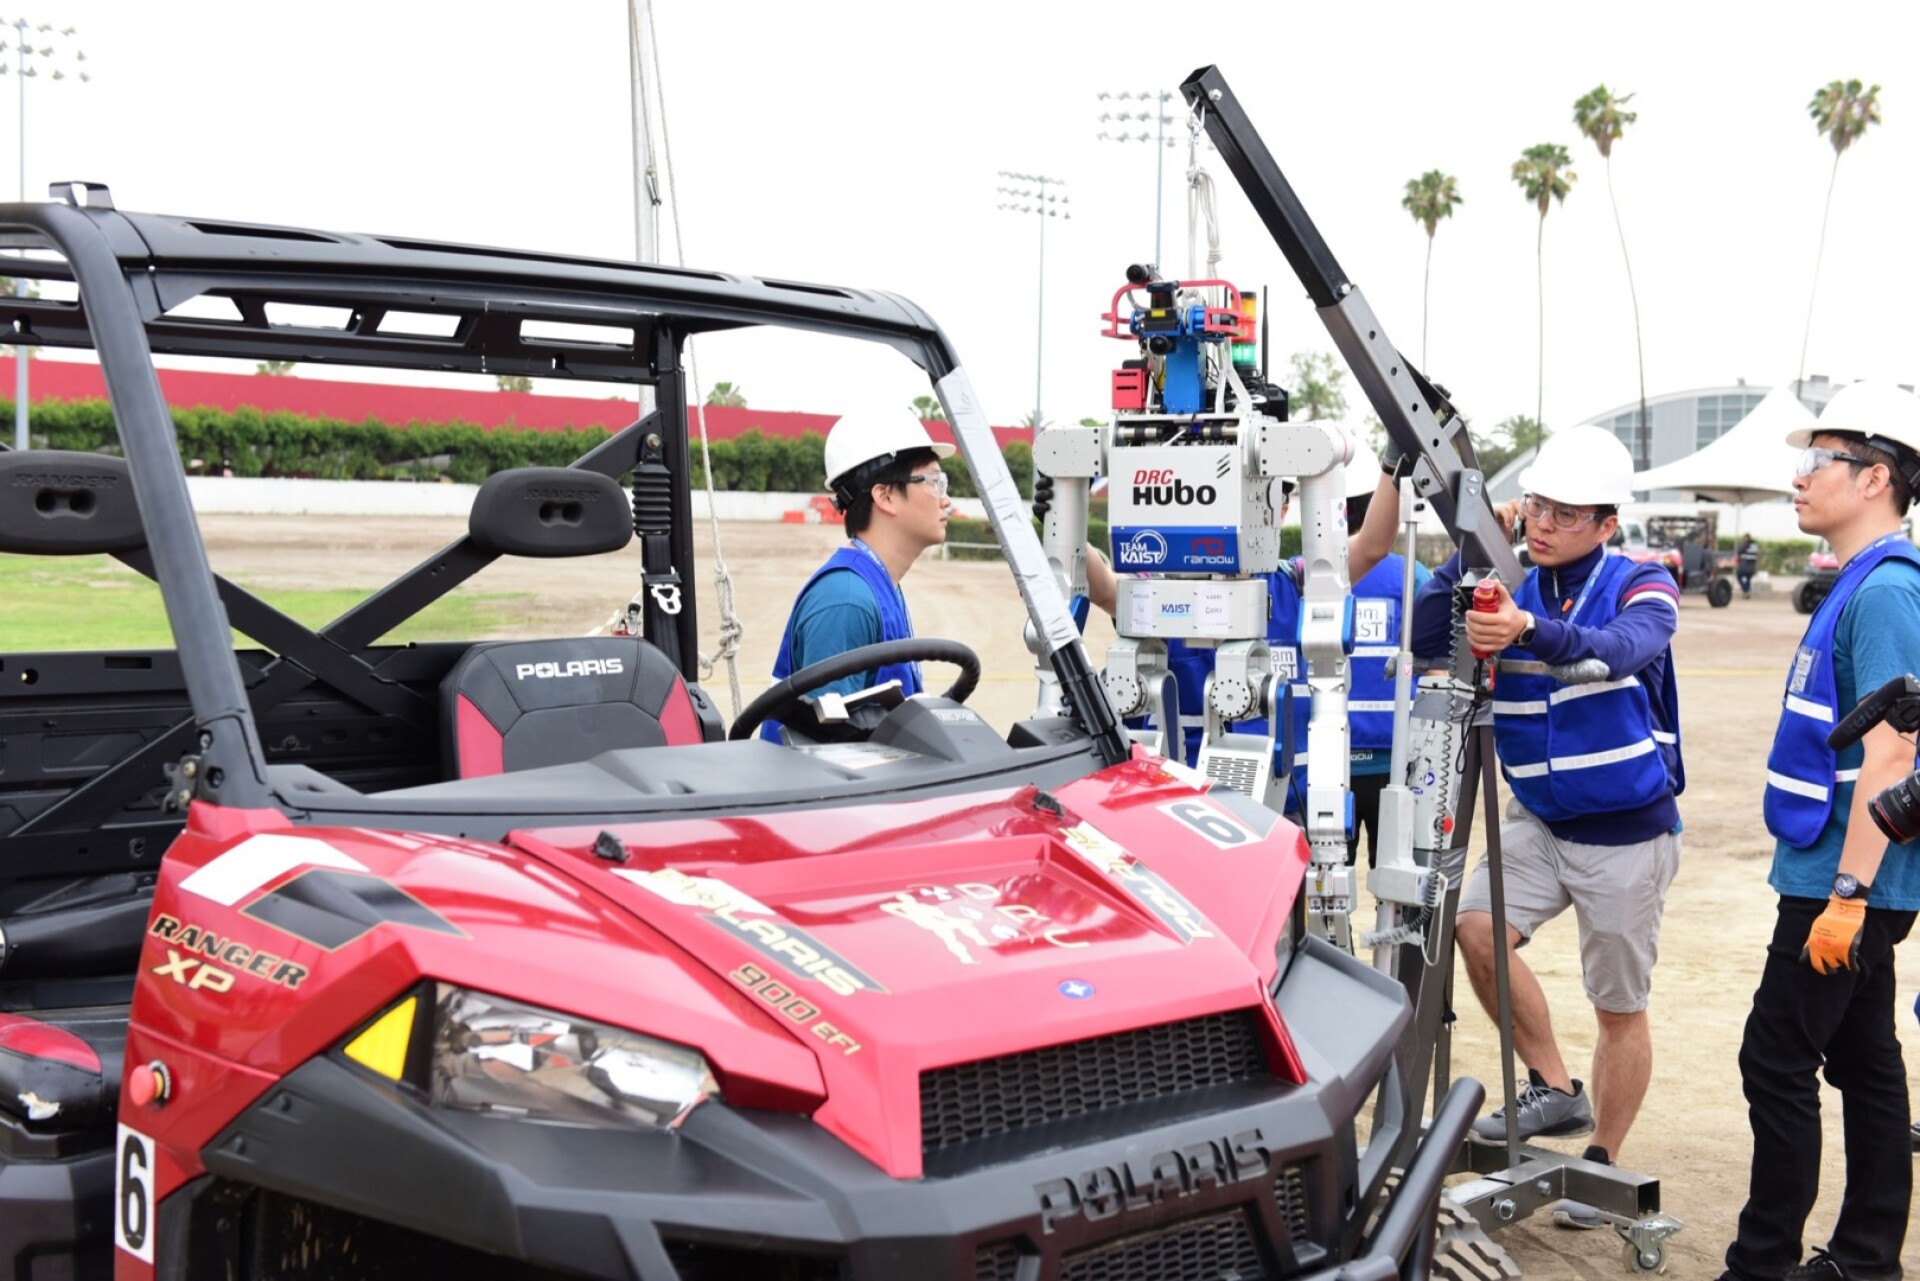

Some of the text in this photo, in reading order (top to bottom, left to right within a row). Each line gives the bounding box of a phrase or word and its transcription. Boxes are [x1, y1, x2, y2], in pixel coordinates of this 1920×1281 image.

[1133, 469, 1174, 485] DRC
[1119, 542, 1148, 553] TEAM
[1120, 551, 1161, 564] KAIST
[1183, 554, 1235, 565] rainbow
[1161, 603, 1191, 614] KAIST
[516, 658, 624, 680] POLARIS
[1272, 650, 1294, 662] am
[1170, 803, 1247, 844] 6
[1058, 827, 1215, 938] POLA
[149, 915, 309, 991] RANGER
[150, 947, 237, 995] XP
[730, 961, 862, 1056] 900 EFI
[121, 1134, 149, 1250] 6
[1033, 1128, 1271, 1235] POLARIS
